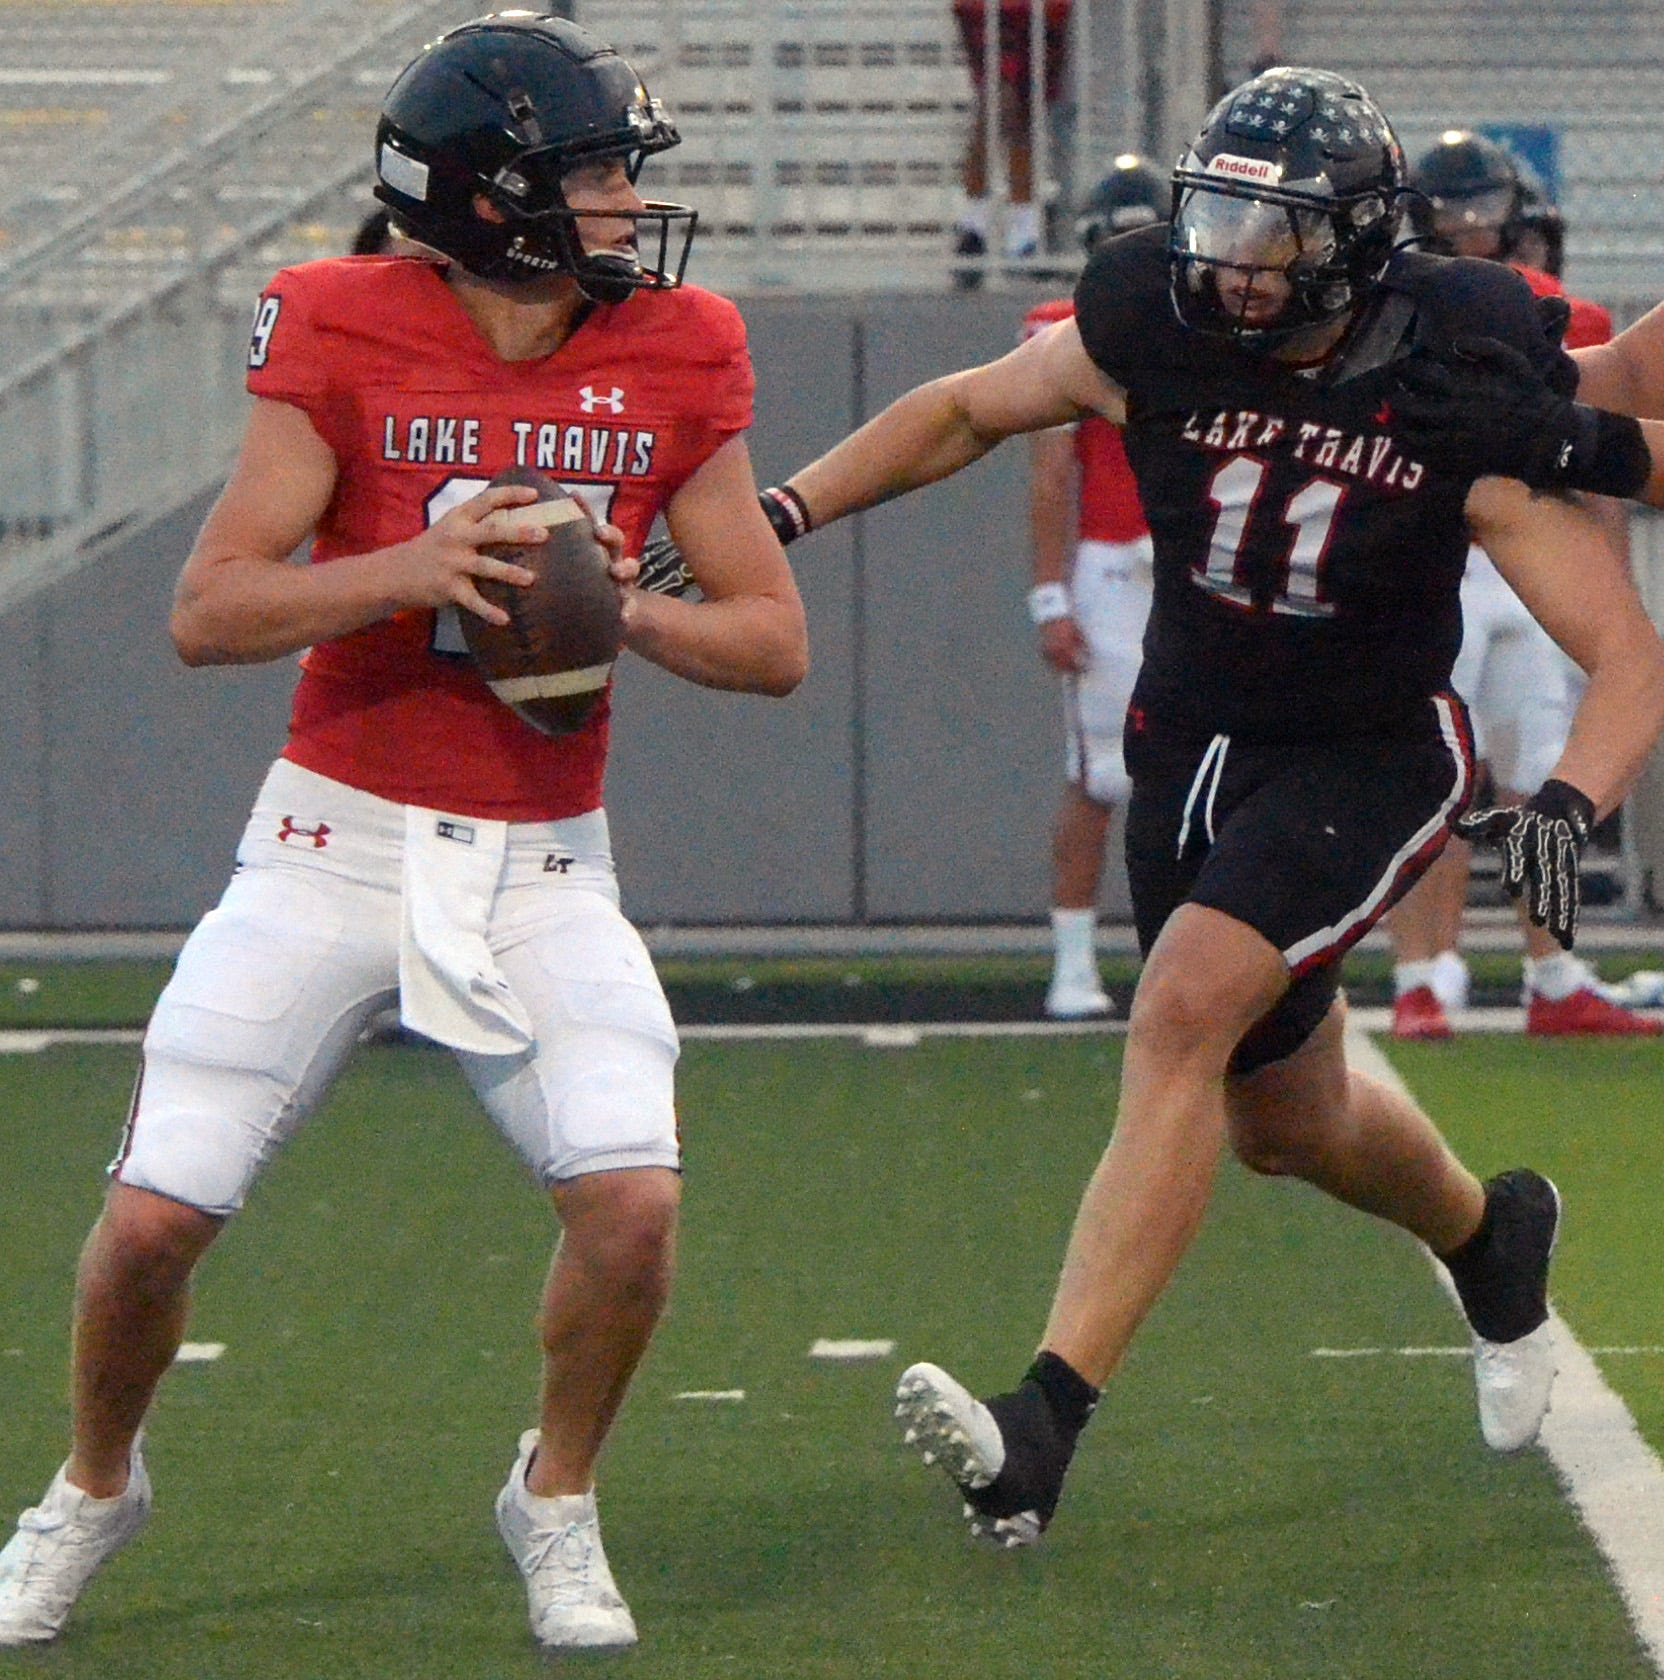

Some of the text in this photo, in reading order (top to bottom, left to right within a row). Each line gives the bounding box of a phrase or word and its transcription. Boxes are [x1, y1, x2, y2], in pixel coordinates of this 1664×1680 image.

[1215, 158, 1269, 178] Riddell
[383, 414, 655, 475] LAKE TRAVIS
[1182, 411, 1284, 449] LAKE
[1189, 452, 1349, 618] 11
[542, 853, 575, 874] LT
